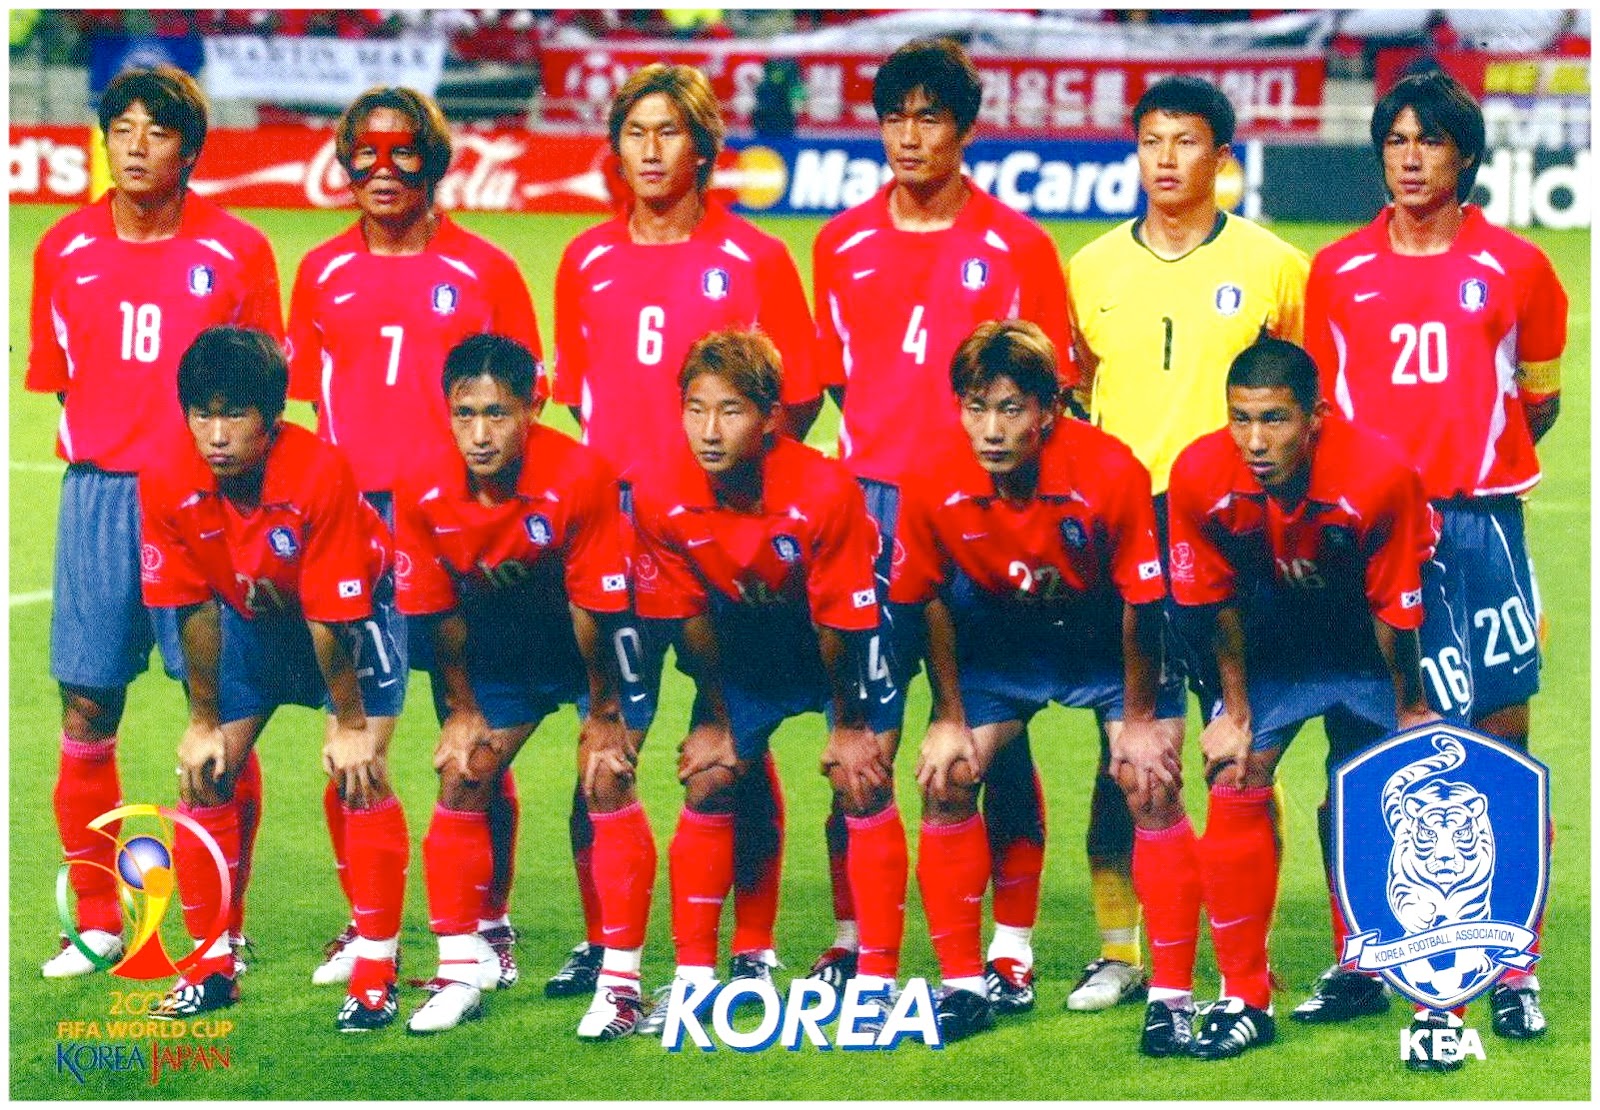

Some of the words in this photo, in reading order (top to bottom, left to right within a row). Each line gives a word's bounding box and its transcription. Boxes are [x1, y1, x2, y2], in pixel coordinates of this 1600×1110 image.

[789, 149, 1140, 213] MarCard
[119, 300, 162, 363] 18
[380, 325, 404, 386] 7
[637, 305, 666, 365] 6
[902, 304, 928, 364] 4
[1161, 316, 1174, 371] 1
[1390, 321, 1449, 385] 20
[1474, 596, 1535, 667] 20
[1420, 646, 1472, 711] 16
